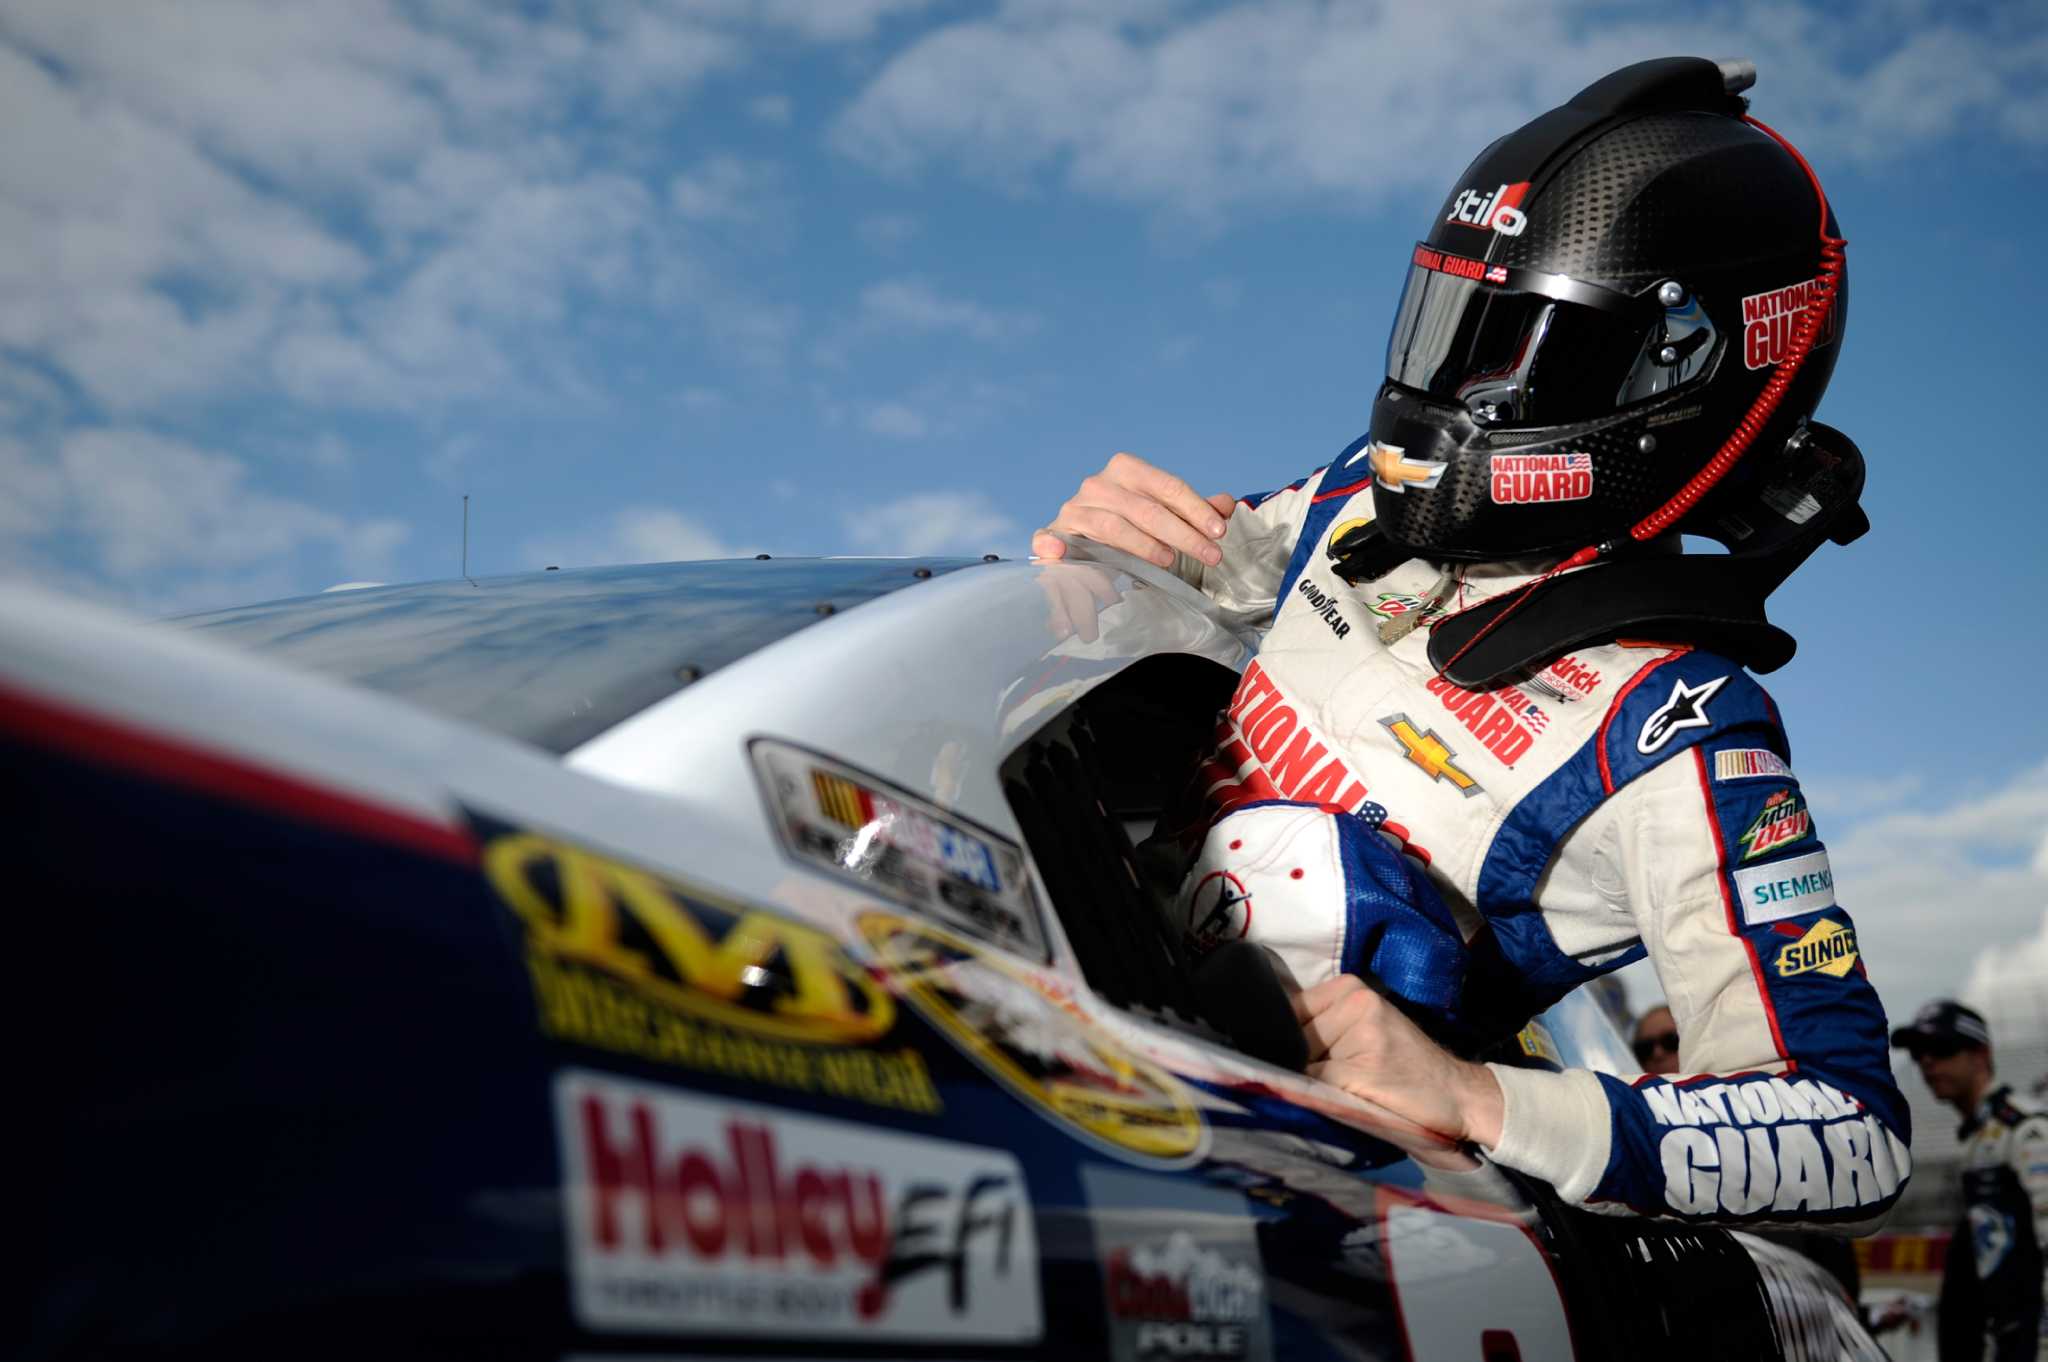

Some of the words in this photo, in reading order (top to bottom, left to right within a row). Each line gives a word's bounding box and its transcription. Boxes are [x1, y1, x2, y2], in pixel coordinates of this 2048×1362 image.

[1442, 255, 1486, 280] GUARD
[1743, 281, 1826, 322] NATIONA
[1492, 456, 1568, 473] NATIONAL
[1493, 471, 1591, 503] GUARD
[1299, 579, 1350, 640] GOODYEAR
[1551, 657, 1601, 695] drick
[1229, 659, 1369, 813] TIONA
[1426, 675, 1534, 766] GUARD
[1786, 930, 1857, 972] SUNOC
[1641, 1078, 1860, 1126] NATIONAL
[1660, 1113, 1912, 1216] GUARD
[580, 1090, 892, 1322] Holley
[1137, 1322, 1246, 1356] POLE
